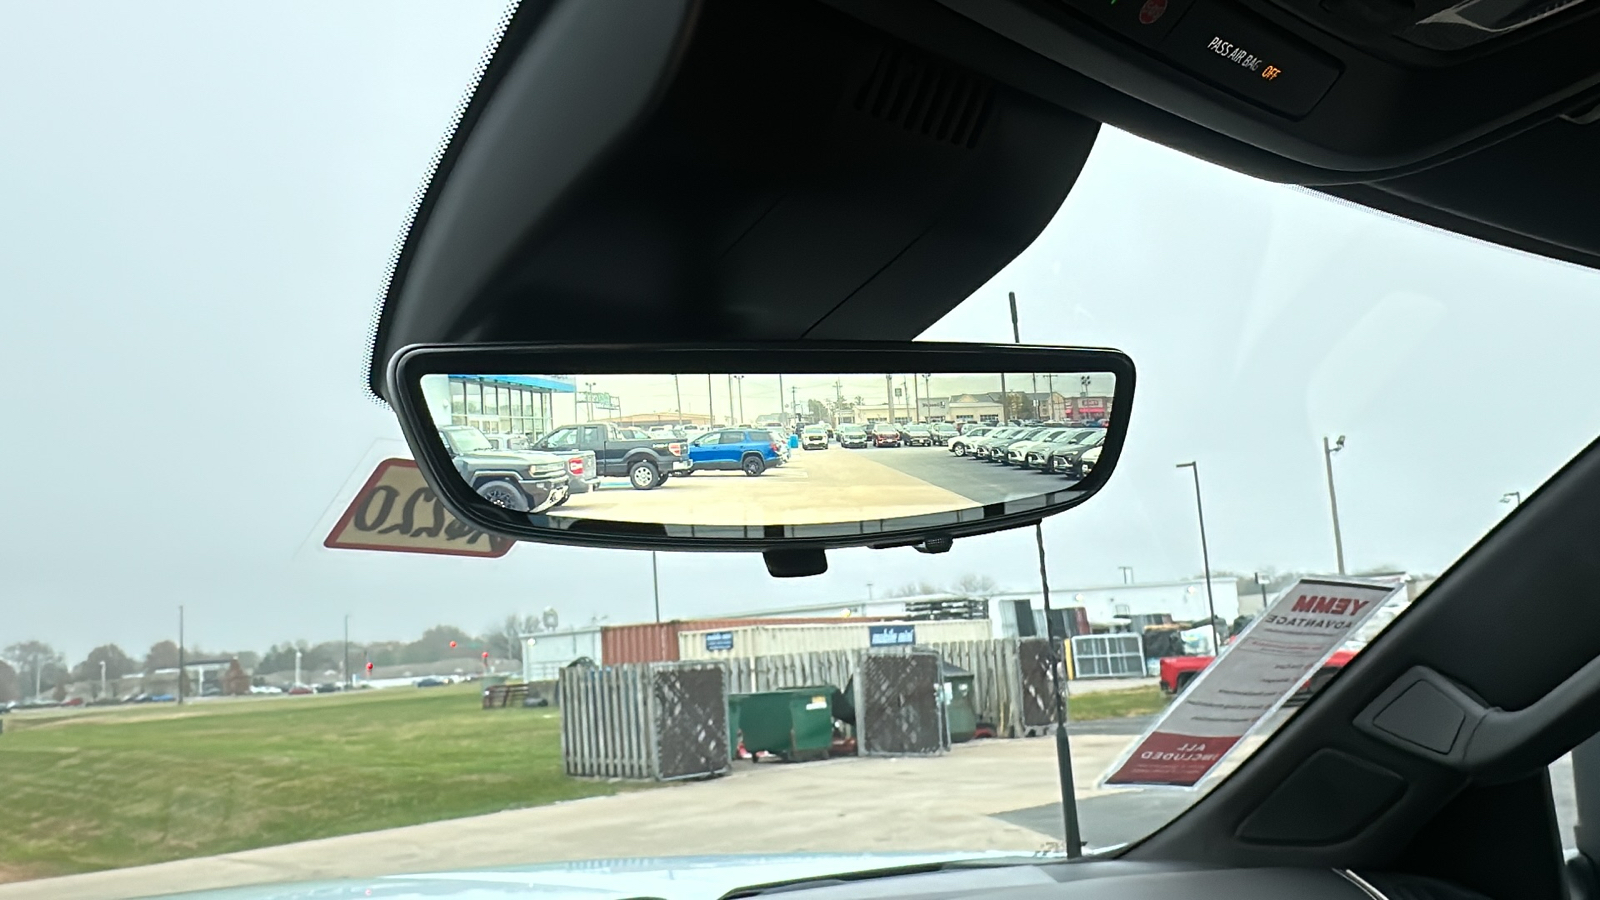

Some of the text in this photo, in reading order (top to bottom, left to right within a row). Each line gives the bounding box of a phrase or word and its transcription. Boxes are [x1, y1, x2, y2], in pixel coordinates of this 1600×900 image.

[1207, 36, 1282, 82] PASS AIR BAG OFF
